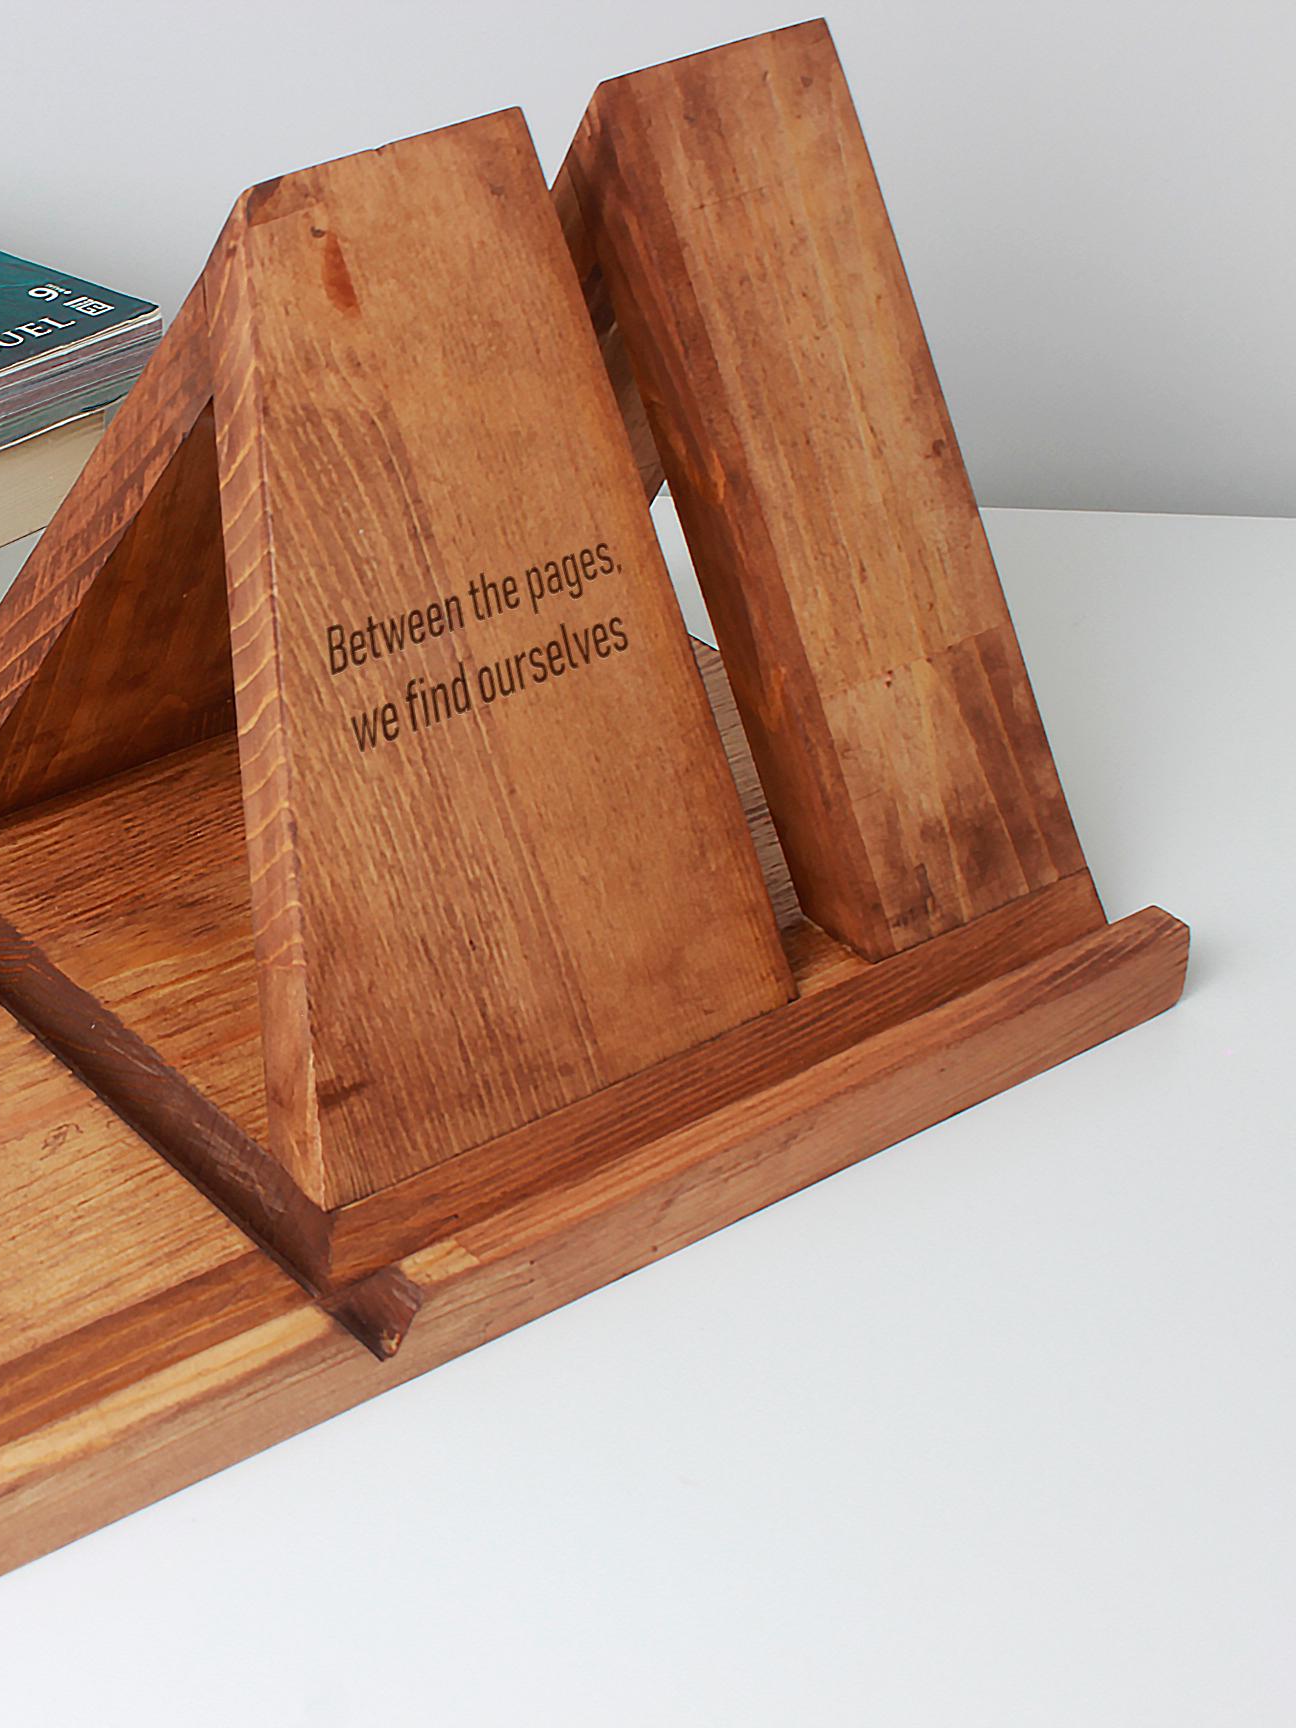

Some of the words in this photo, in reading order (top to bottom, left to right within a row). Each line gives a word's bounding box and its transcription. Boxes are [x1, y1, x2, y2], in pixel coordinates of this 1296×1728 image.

[326, 594, 465, 676] Between
[468, 572, 520, 621] the
[525, 542, 623, 614] pages,
[350, 701, 400, 752] we
[405, 662, 472, 733] find
[477, 616, 629, 704] ourselves
